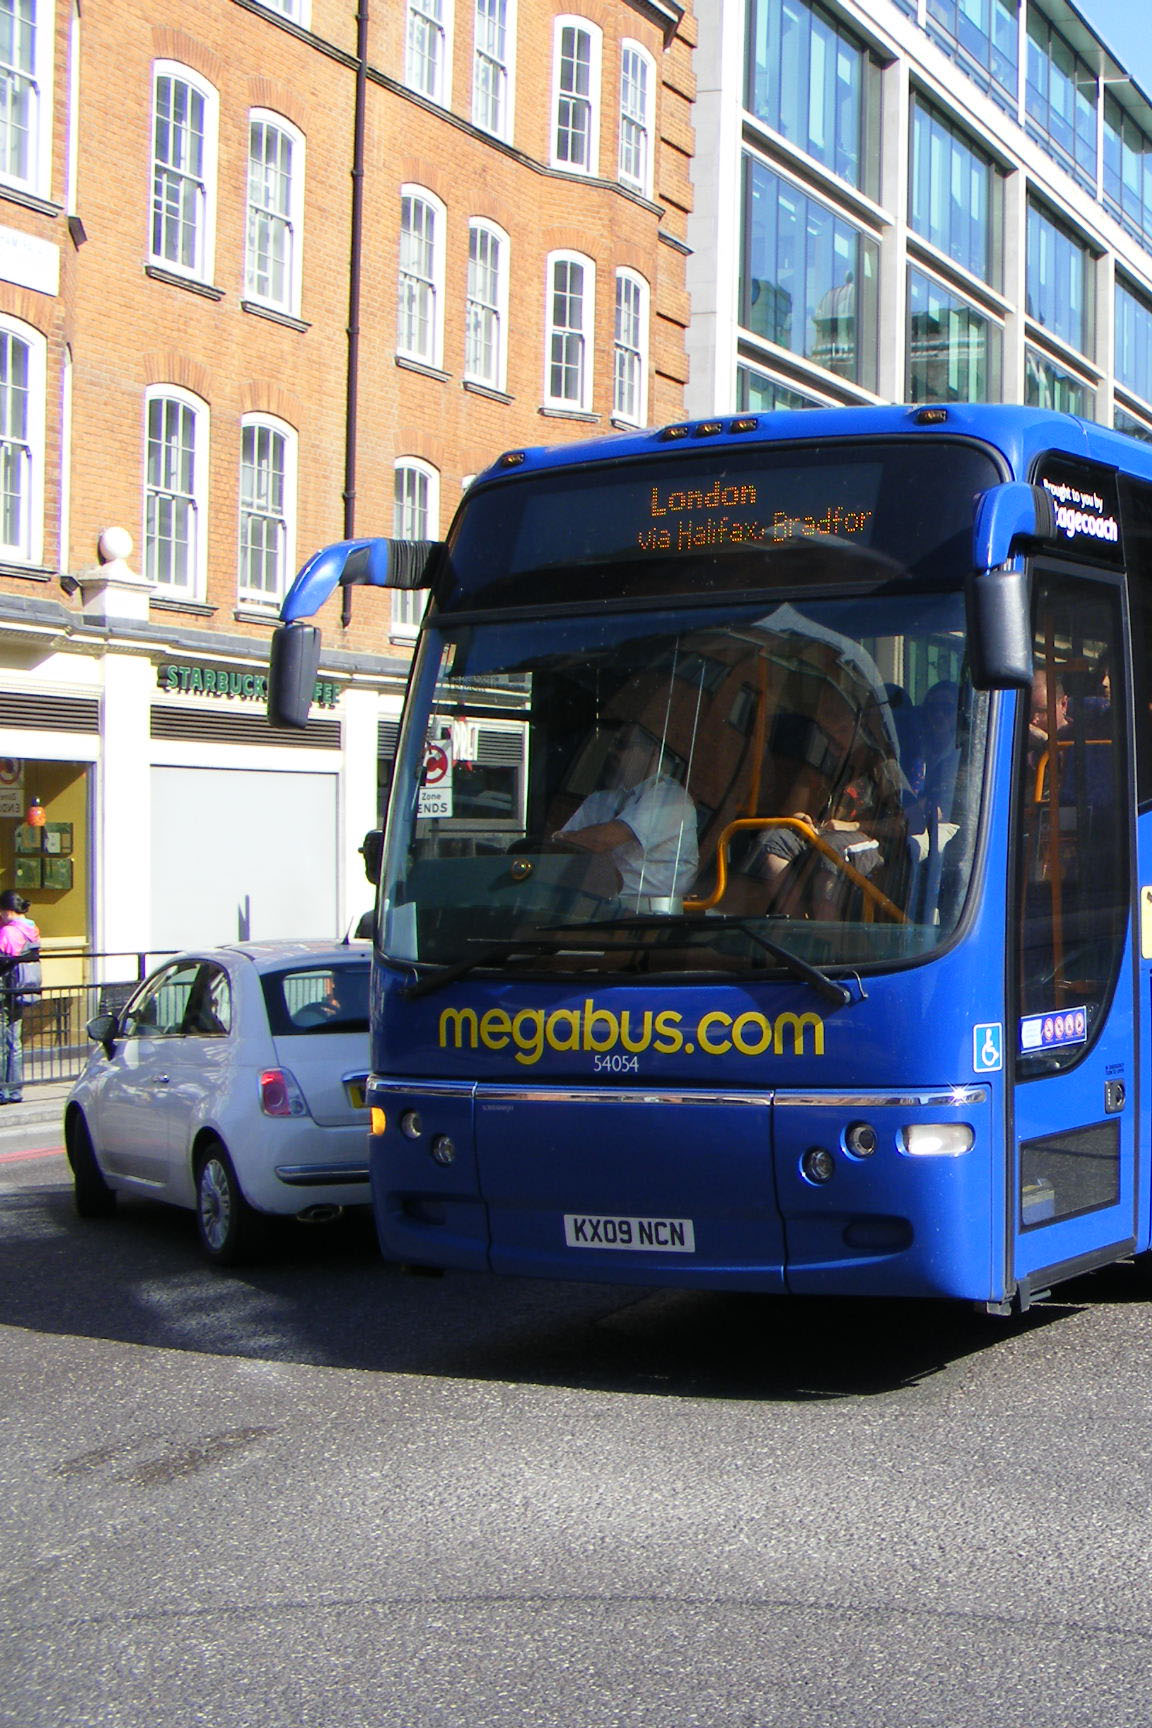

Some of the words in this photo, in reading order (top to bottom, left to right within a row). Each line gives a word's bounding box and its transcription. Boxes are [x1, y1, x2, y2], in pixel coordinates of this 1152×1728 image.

[650, 481, 757, 516] London
[1071, 487, 1080, 503] to
[1080, 492, 1094, 508] you
[1093, 491, 1104, 514] by
[1053, 499, 1118, 541] tagecoach
[637, 528, 671, 551] via
[165, 664, 269, 698] STARBUCK
[312, 682, 342, 704] FEE
[421, 793, 442, 801] Zone
[438, 998, 825, 1066] megabus.com
[593, 1055, 640, 1073] 54054
[573, 1217, 633, 1244] KX09
[638, 1221, 685, 1247] NCN
